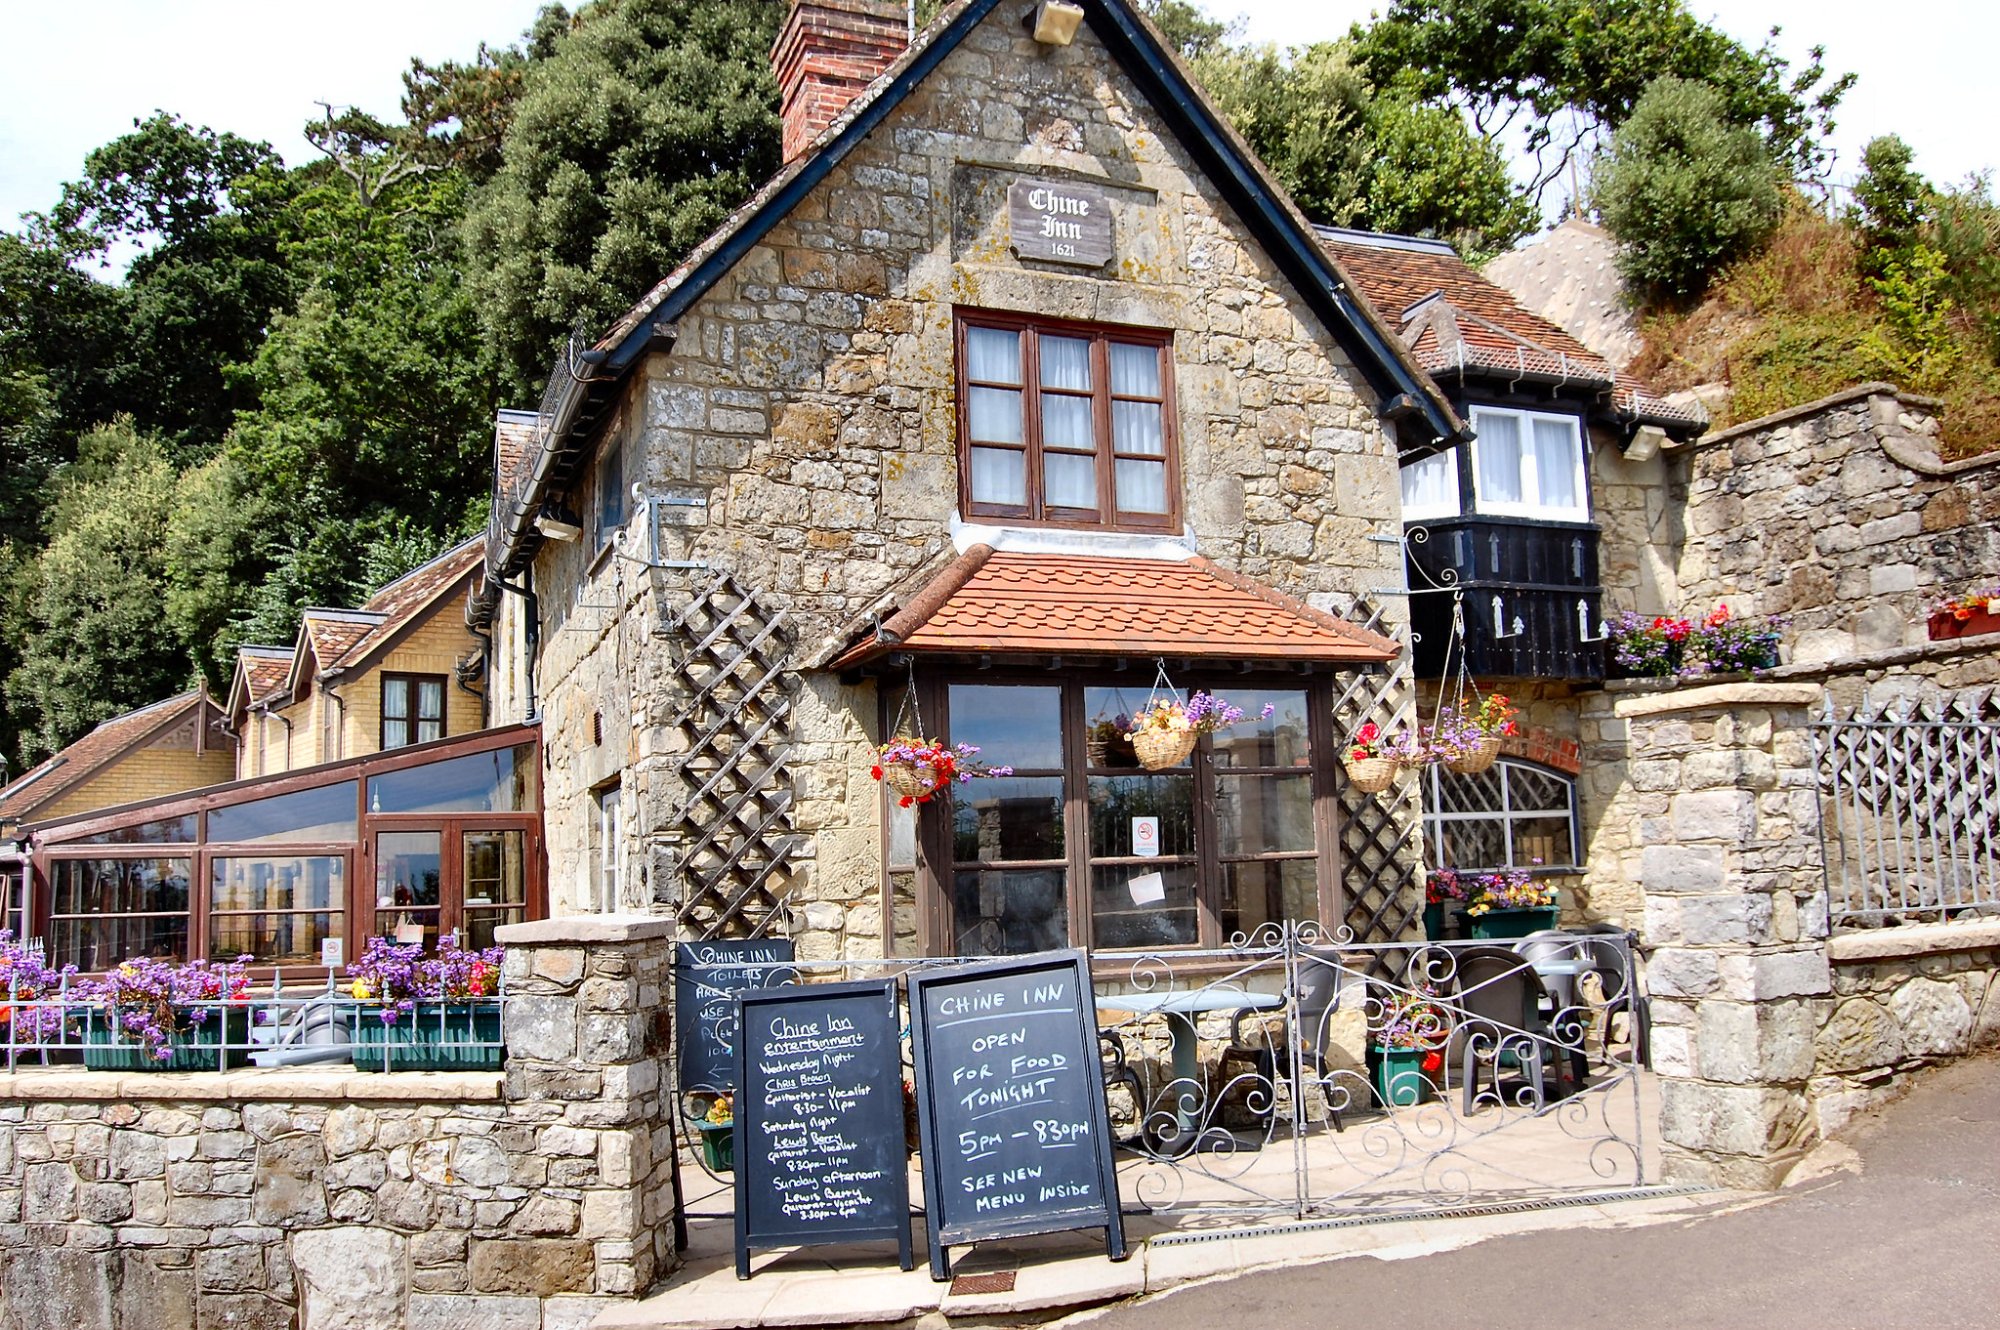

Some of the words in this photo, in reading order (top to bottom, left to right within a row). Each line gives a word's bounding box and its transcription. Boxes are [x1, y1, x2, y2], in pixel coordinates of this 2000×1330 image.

[1028, 188, 1089, 216] Chine
[1039, 214, 1082, 240] Inn
[1051, 243, 1075, 257] 1621
[750, 949, 777, 962] INN
[940, 989, 1005, 1015] CHINE
[1023, 983, 1063, 1005] INN
[700, 1007, 725, 1018] USE
[770, 1017, 820, 1039] Chine
[826, 1013, 854, 1031] Inn
[972, 1027, 1026, 1052] OPEN
[759, 1056, 820, 1074] Wednesday
[952, 1064, 993, 1086] FOR
[1011, 1053, 1067, 1075] FOOD
[800, 1073, 832, 1086] Brown
[764, 1092, 817, 1107] Guitarist
[828, 1083, 871, 1099] Vocalist
[960, 1078, 1055, 1111] TONIGHT
[828, 1099, 856, 1113] 11pm
[761, 1119, 807, 1135] Saturday
[774, 1136, 807, 1150] Lewis
[773, 1175, 819, 1190] Sunday
[822, 1171, 881, 1184] afternoon
[961, 1173, 996, 1192] SEE
[1003, 1165, 1042, 1184] NEW
[784, 1191, 821, 1202] Lewis
[976, 1193, 1025, 1212] MENU
[1040, 1180, 1090, 1202] INSIDE
